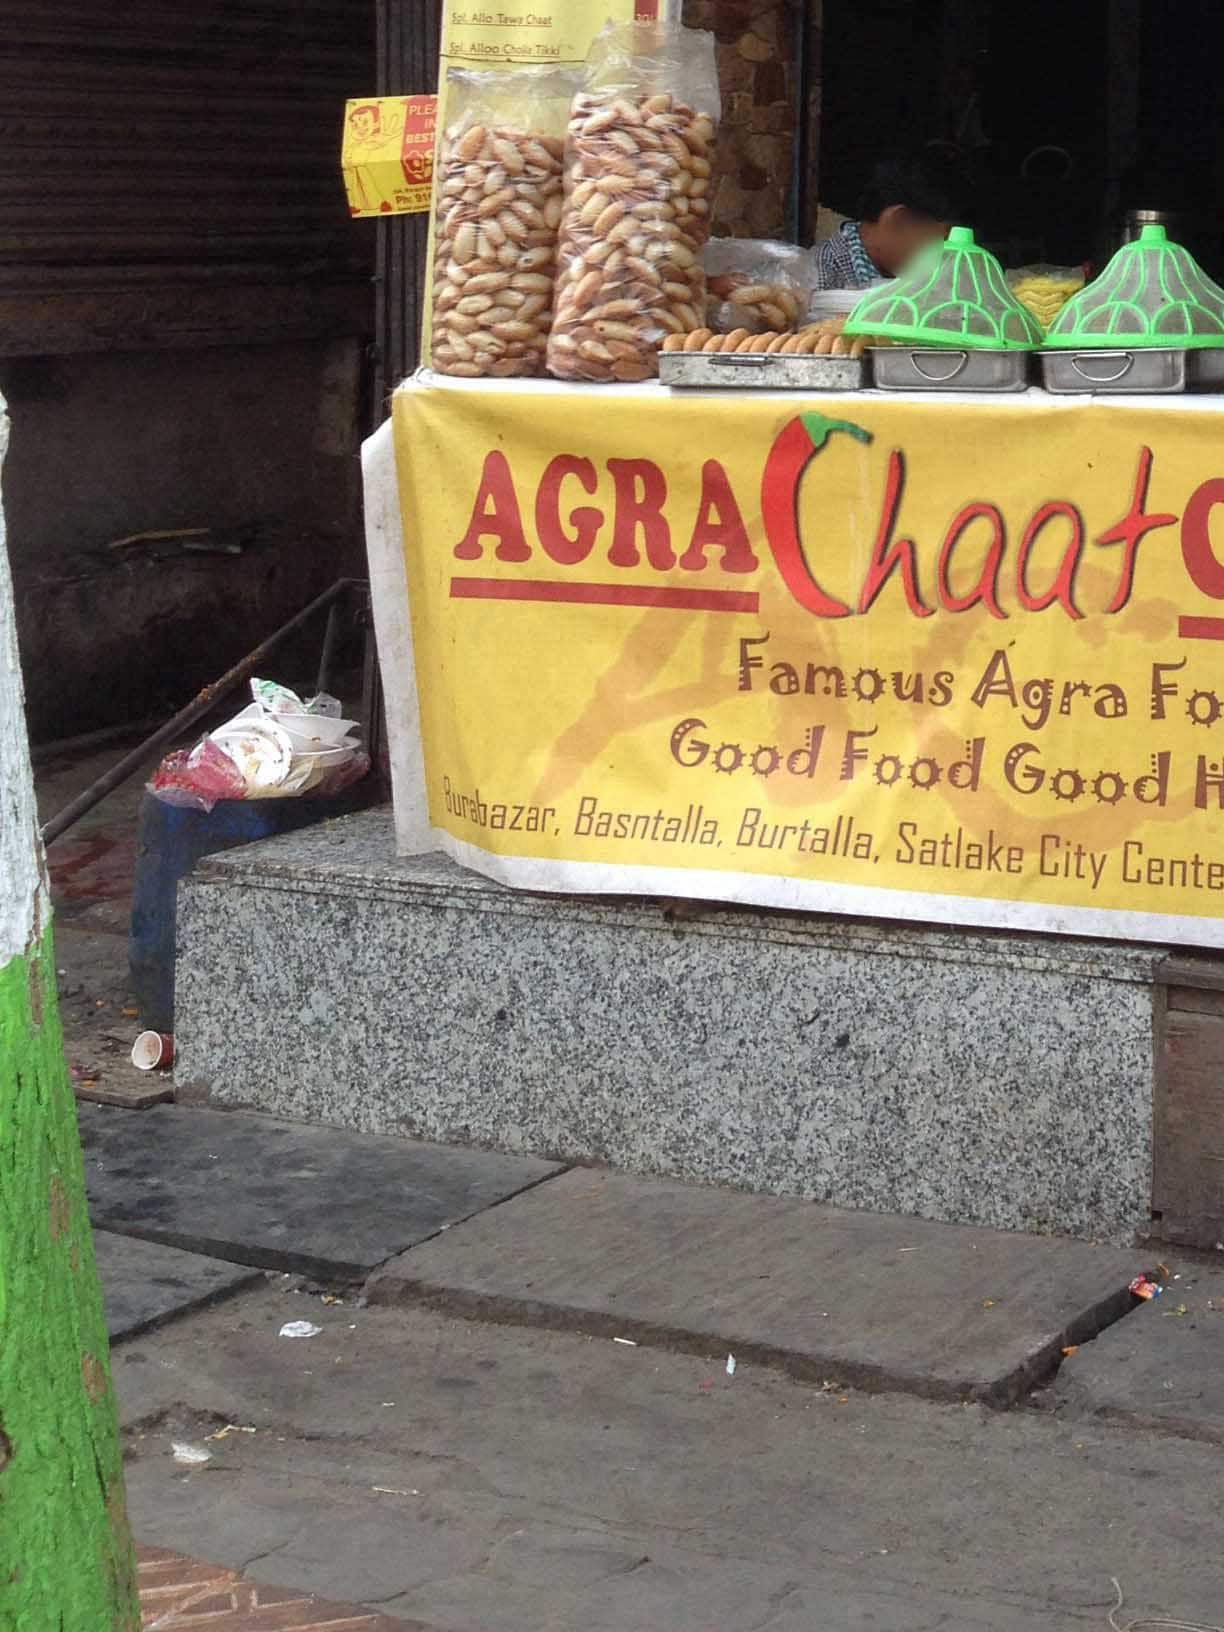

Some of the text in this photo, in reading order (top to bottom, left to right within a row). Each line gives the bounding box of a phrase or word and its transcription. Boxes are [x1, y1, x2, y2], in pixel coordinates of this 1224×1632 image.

[453, 450, 758, 573] AGRA
[760, 410, 1179, 619] Chaat
[737, 630, 953, 709] Famous
[970, 643, 1127, 730] Agra
[669, 717, 825, 779] Good
[839, 722, 985, 793] Food
[1002, 741, 1171, 809] Good
[574, 795, 723, 850] Basntalla,
[737, 807, 880, 865] Burtalla,
[896, 822, 1024, 875] Satlake
[1038, 834, 1107, 889] City
